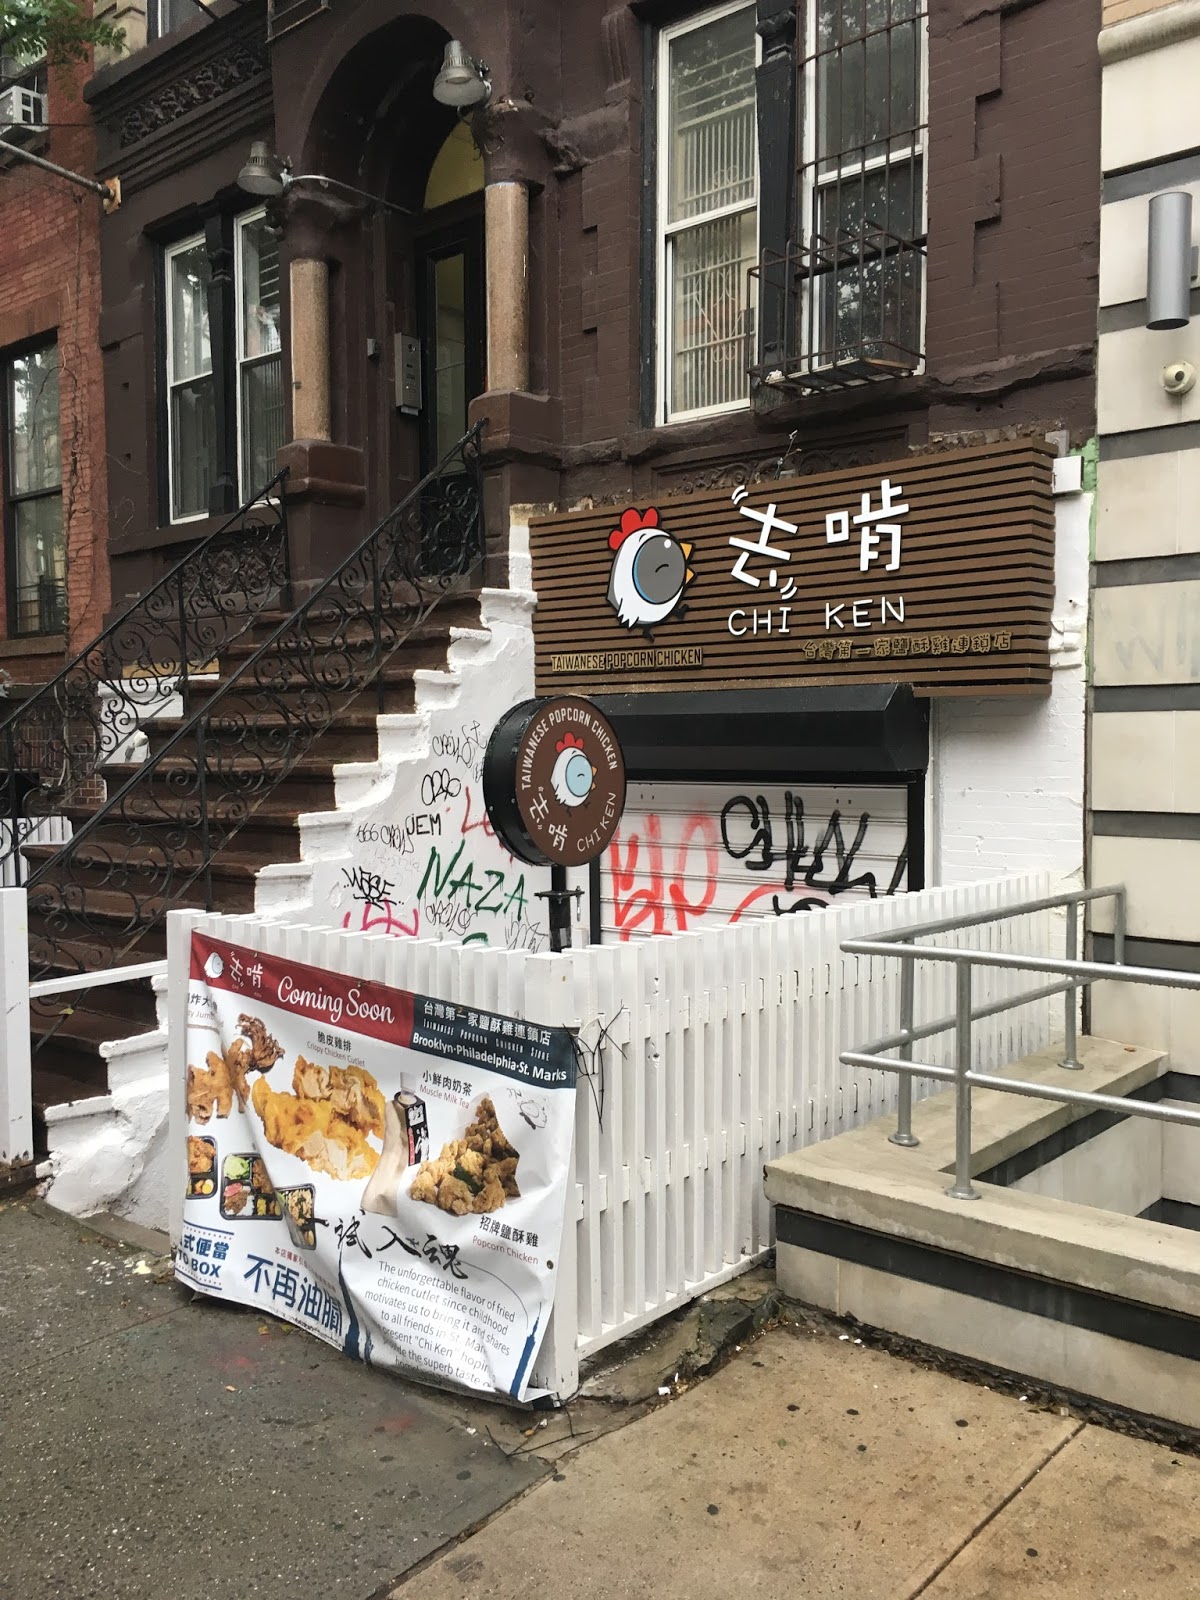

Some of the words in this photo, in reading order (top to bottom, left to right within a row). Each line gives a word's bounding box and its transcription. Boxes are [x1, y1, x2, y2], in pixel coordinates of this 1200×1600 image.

[728, 607, 792, 636] CHI
[825, 596, 904, 630] KEN
[551, 653, 605, 672] TAIWANESE
[606, 650, 655, 669] POPCORN
[656, 647, 702, 667] CHICKEN
[802, 632, 1012, 660] 台灣第一家鹽酥雞連鎖店
[522, 719, 549, 790] TAIWANESE
[549, 707, 592, 727] POPCORN
[591, 721, 618, 770] CHICKEN
[577, 828, 602, 852] CHI
[600, 792, 617, 831] KEN
[417, 838, 529, 922] NAZA
[278, 976, 343, 1023] Coming
[347, 989, 395, 1024] Soon
[423, 1019, 454, 1036] TAIWANESE
[460, 1029, 488, 1044] POPCORN
[495, 1039, 524, 1053] CHICKEN
[530, 1047, 550, 1061] STORE
[424, 1001, 552, 1046] 台灣第一家鹽酥雞連鎖店
[307, 1041, 324, 1054] Crispy
[325, 1047, 347, 1060] Chicken
[347, 1055, 365, 1067] Cutlet
[317, 1031, 352, 1052] 脆皮雞排
[422, 1070, 473, 1096] 小鮮肉奶茶
[532, 1067, 567, 1081] Marks
[419, 1085, 443, 1100] Muscle
[444, 1093, 458, 1105] Milk
[459, 1098, 470, 1109] Tea
[179, 1234, 230, 1260] 式便當
[479, 1215, 539, 1248] 招牌鹽酥雞
[472, 1235, 505, 1252] Popcorn
[506, 1247, 539, 1265] Chicken
[191, 1258, 221, 1278] BOX
[377, 1277, 410, 1295] chicken
[411, 1287, 440, 1304] cutlet
[442, 1297, 467, 1313] since
[469, 1306, 508, 1335] childhood
[379, 1261, 396, 1275] The
[398, 1266, 459, 1295] unforgettable
[461, 1286, 486, 1305] flavor
[487, 1300, 496, 1311] of
[496, 1304, 515, 1323] fried
[365, 1289, 406, 1311] motivates
[408, 1303, 418, 1314] us
[420, 1306, 430, 1318] to
[432, 1309, 461, 1330] bring
[462, 1319, 470, 1331] it
[486, 1330, 510, 1356] shares
[381, 1309, 389, 1321] to
[391, 1312, 403, 1326] all
[404, 1315, 434, 1335] friends
[408, 1349, 422, 1363] the
[424, 1358, 454, 1375] superb
[455, 1367, 480, 1385] taste
